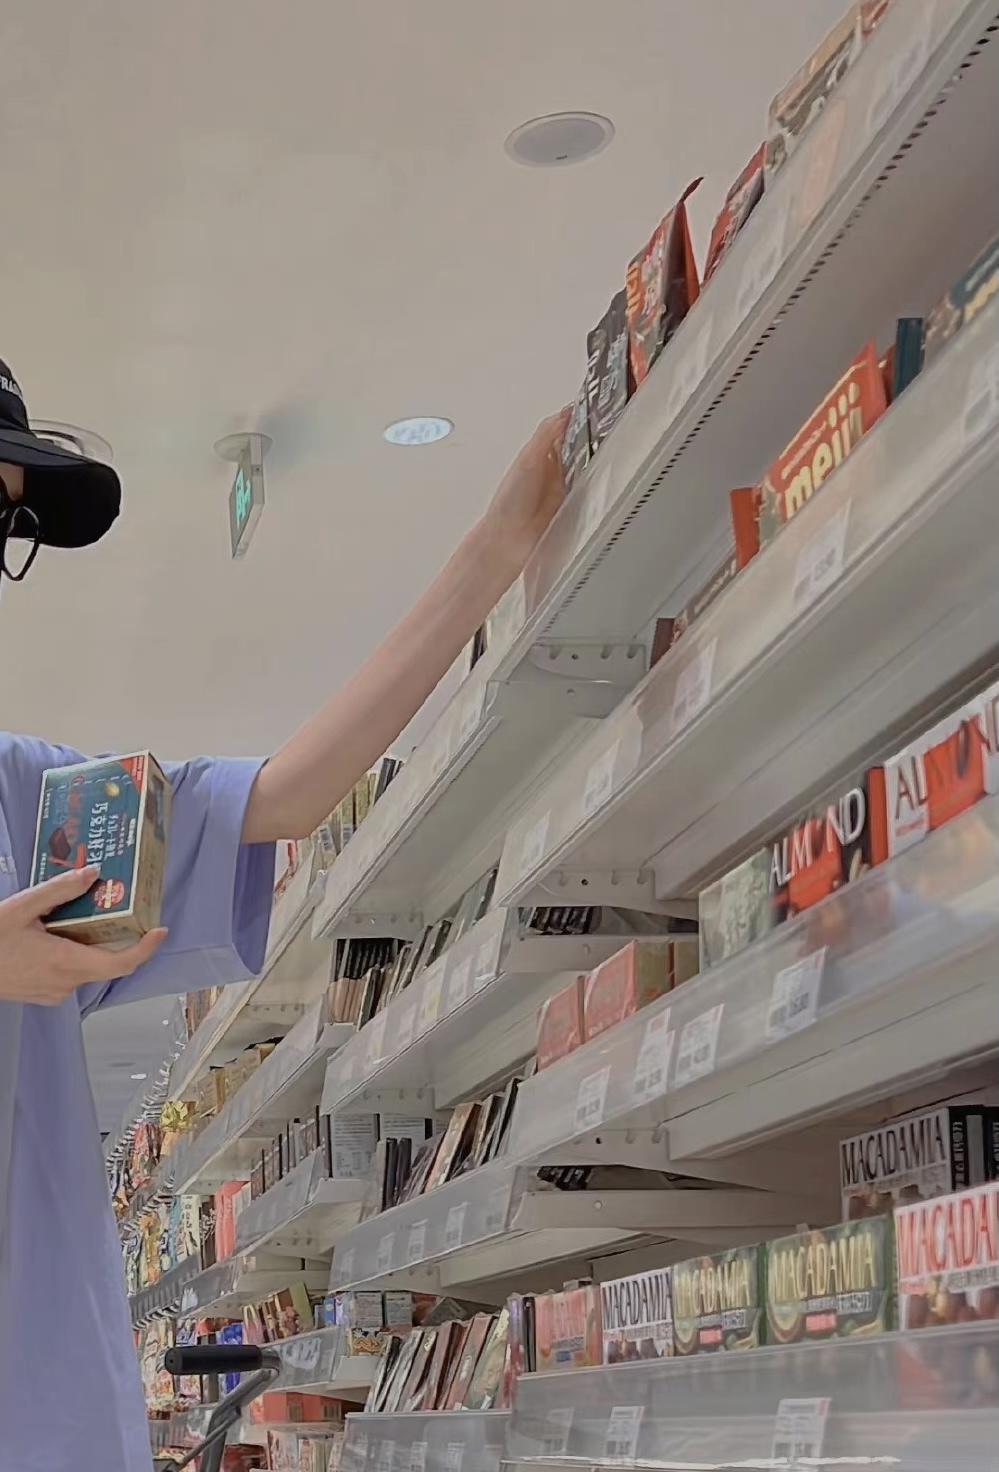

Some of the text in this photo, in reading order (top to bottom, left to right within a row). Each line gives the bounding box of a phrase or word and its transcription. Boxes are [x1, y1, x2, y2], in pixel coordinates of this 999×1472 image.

[785, 382, 864, 519] meiji
[842, 1115, 946, 1188] MACADAMIA
[772, 1232, 877, 1300] MACADAMIA
[897, 1190, 999, 1277] MACADA
[602, 1271, 673, 1328] MACADAMIA
